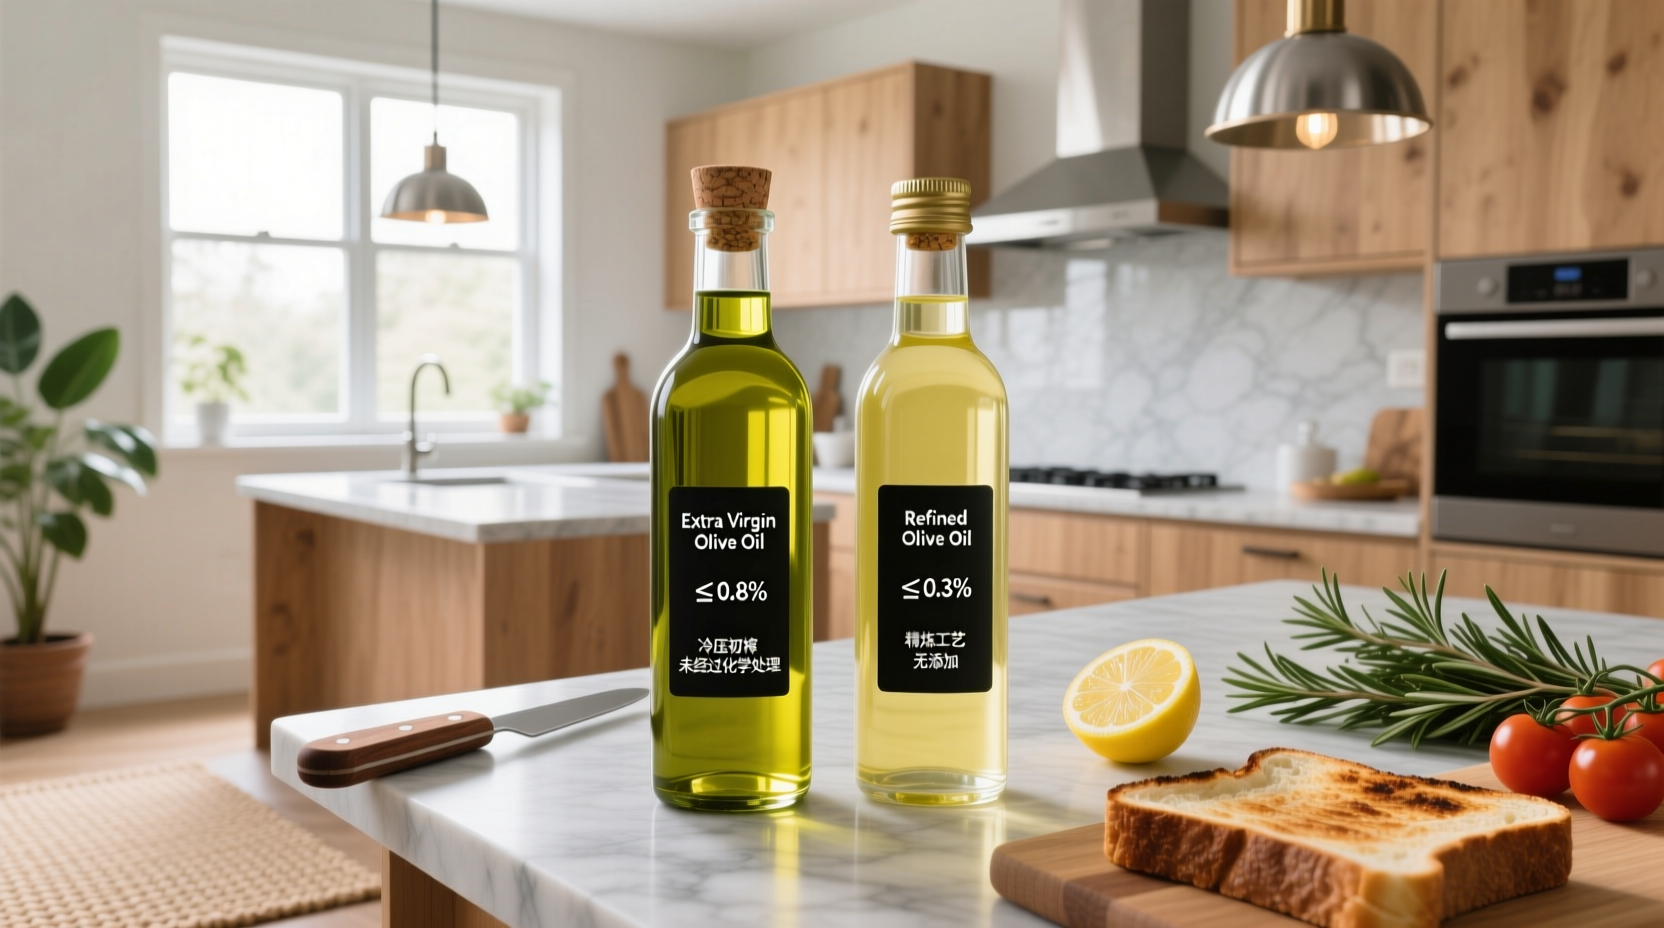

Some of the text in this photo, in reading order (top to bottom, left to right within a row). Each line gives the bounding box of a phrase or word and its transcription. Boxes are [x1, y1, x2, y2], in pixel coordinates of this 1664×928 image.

[681, 511, 776, 533] Extra Virgin
[904, 508, 968, 527] Refined
[694, 532, 765, 551] Olive Oil
[901, 529, 972, 547] Olive Oil
